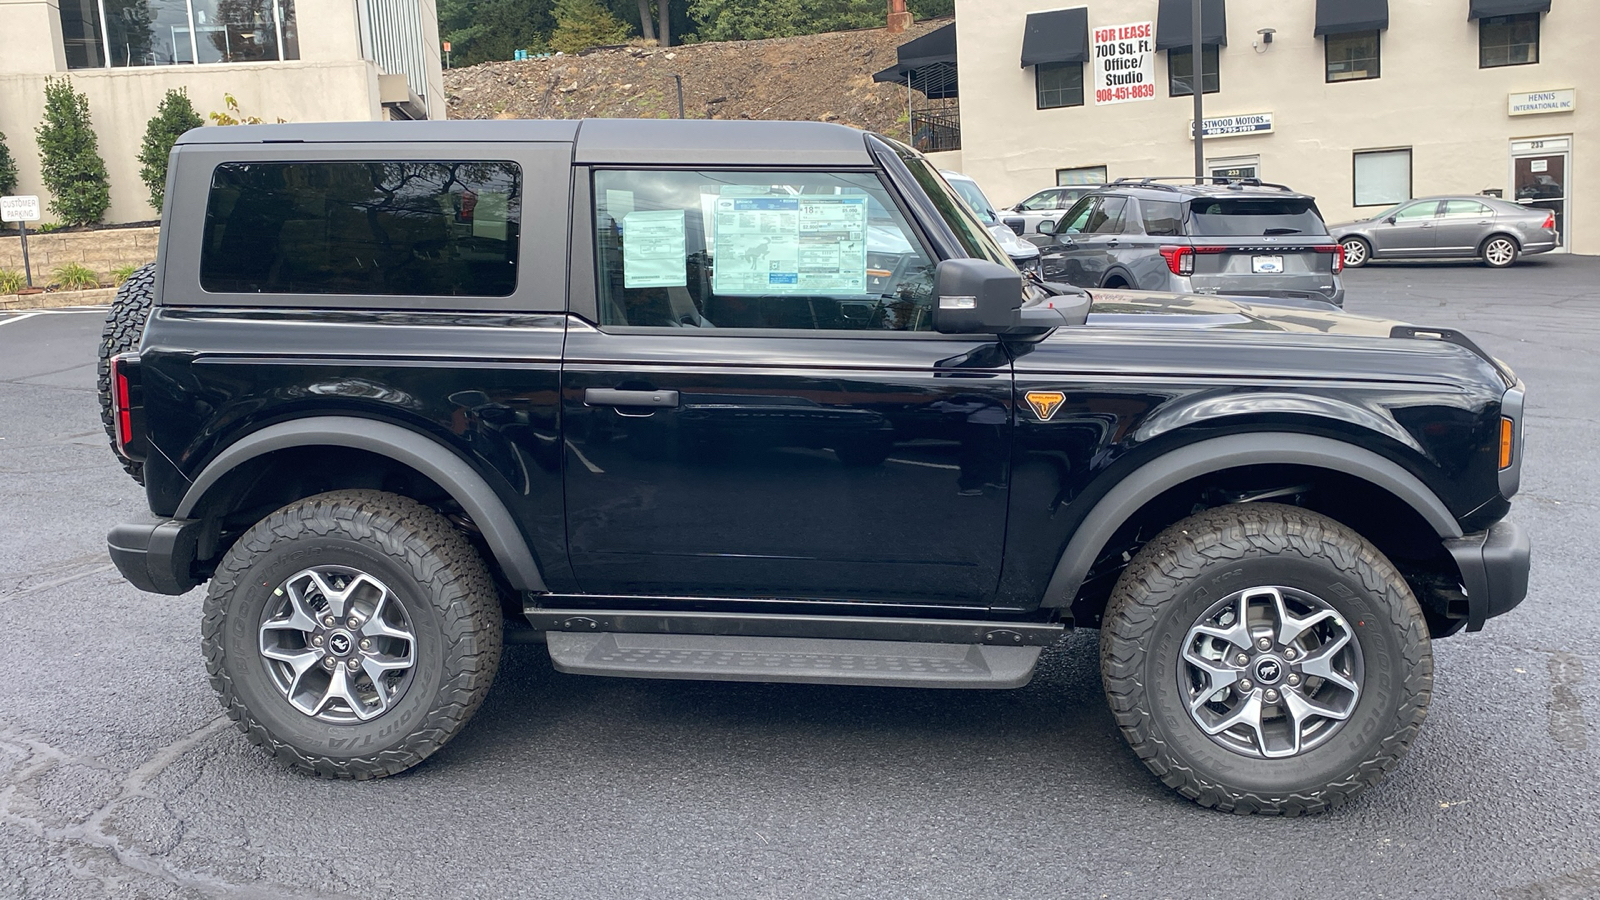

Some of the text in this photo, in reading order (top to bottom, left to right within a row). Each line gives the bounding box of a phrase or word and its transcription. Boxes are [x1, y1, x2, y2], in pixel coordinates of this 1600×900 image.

[1095, 23, 1151, 43] FOR LEASE
[1095, 40, 1152, 58] 700 Sq. Ft.
[1104, 55, 1143, 71] Office/
[1105, 71, 1143, 86] Studio
[1096, 83, 1154, 102] 908-451-8839
[1528, 92, 1555, 102] HENNIS
[1513, 102, 1559, 112] INTERNATIONAL
[1191, 118, 1233, 129] CSTWOOD
[1235, 115, 1264, 126] MOTORS
[1530, 141, 1544, 149] 233
[3, 199, 36, 208] CUSTOMER
[804, 206, 814, 214] 18
[7, 209, 34, 218] PARKING
[234, 546, 322, 674] BFGoodrich
[1327, 581, 1392, 753] BFGoodrich
